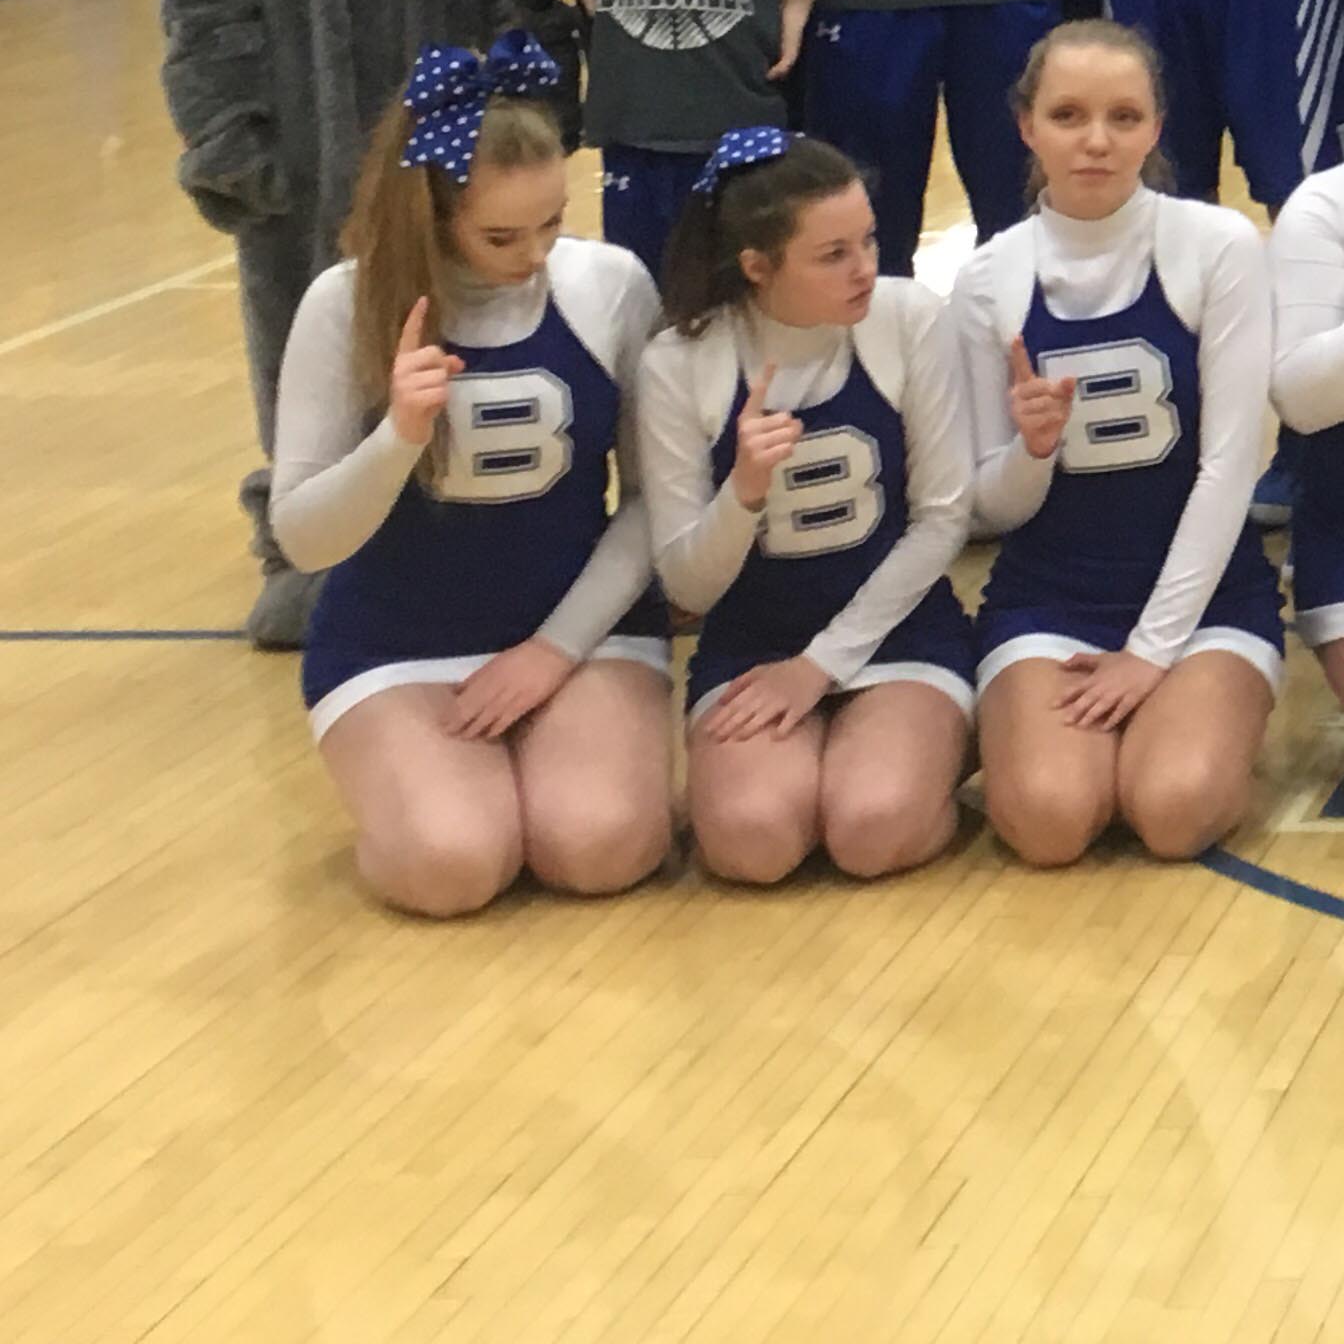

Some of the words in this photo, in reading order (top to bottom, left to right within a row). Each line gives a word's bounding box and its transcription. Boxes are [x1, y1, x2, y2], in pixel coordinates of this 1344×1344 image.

[434, 367, 575, 504] B
[1037, 337, 1181, 474] B
[759, 425, 886, 558] B
